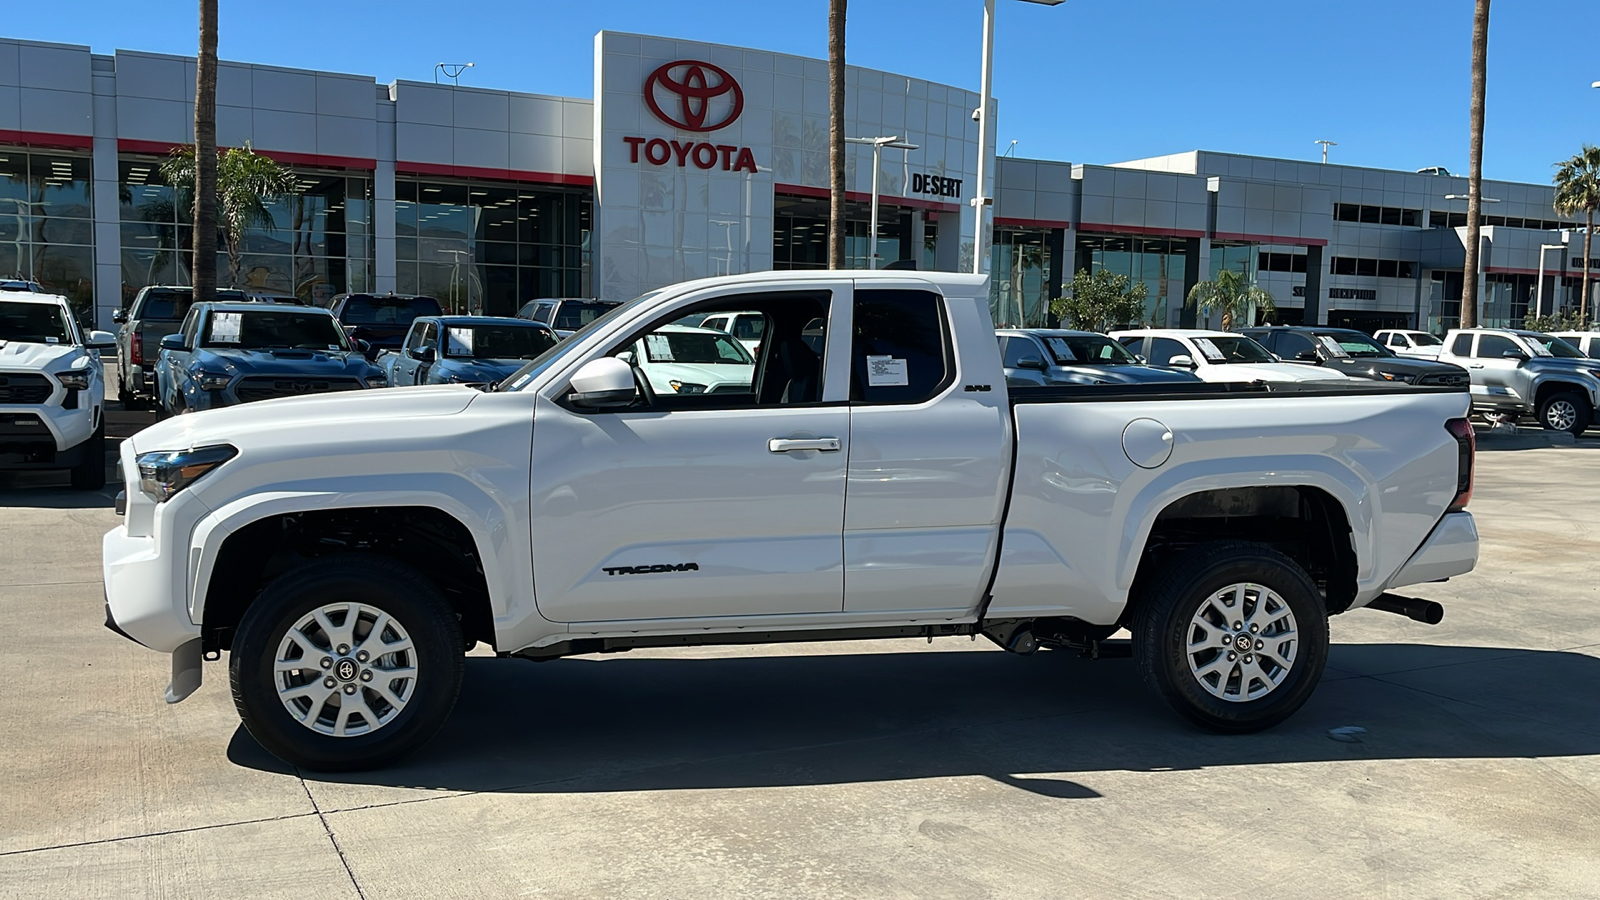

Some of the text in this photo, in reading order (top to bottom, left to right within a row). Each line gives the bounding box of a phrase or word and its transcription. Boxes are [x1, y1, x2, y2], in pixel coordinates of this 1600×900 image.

[624, 136, 758, 173] TOYOTA
[911, 173, 963, 199] DESERT
[602, 562, 699, 576] TACOMA
